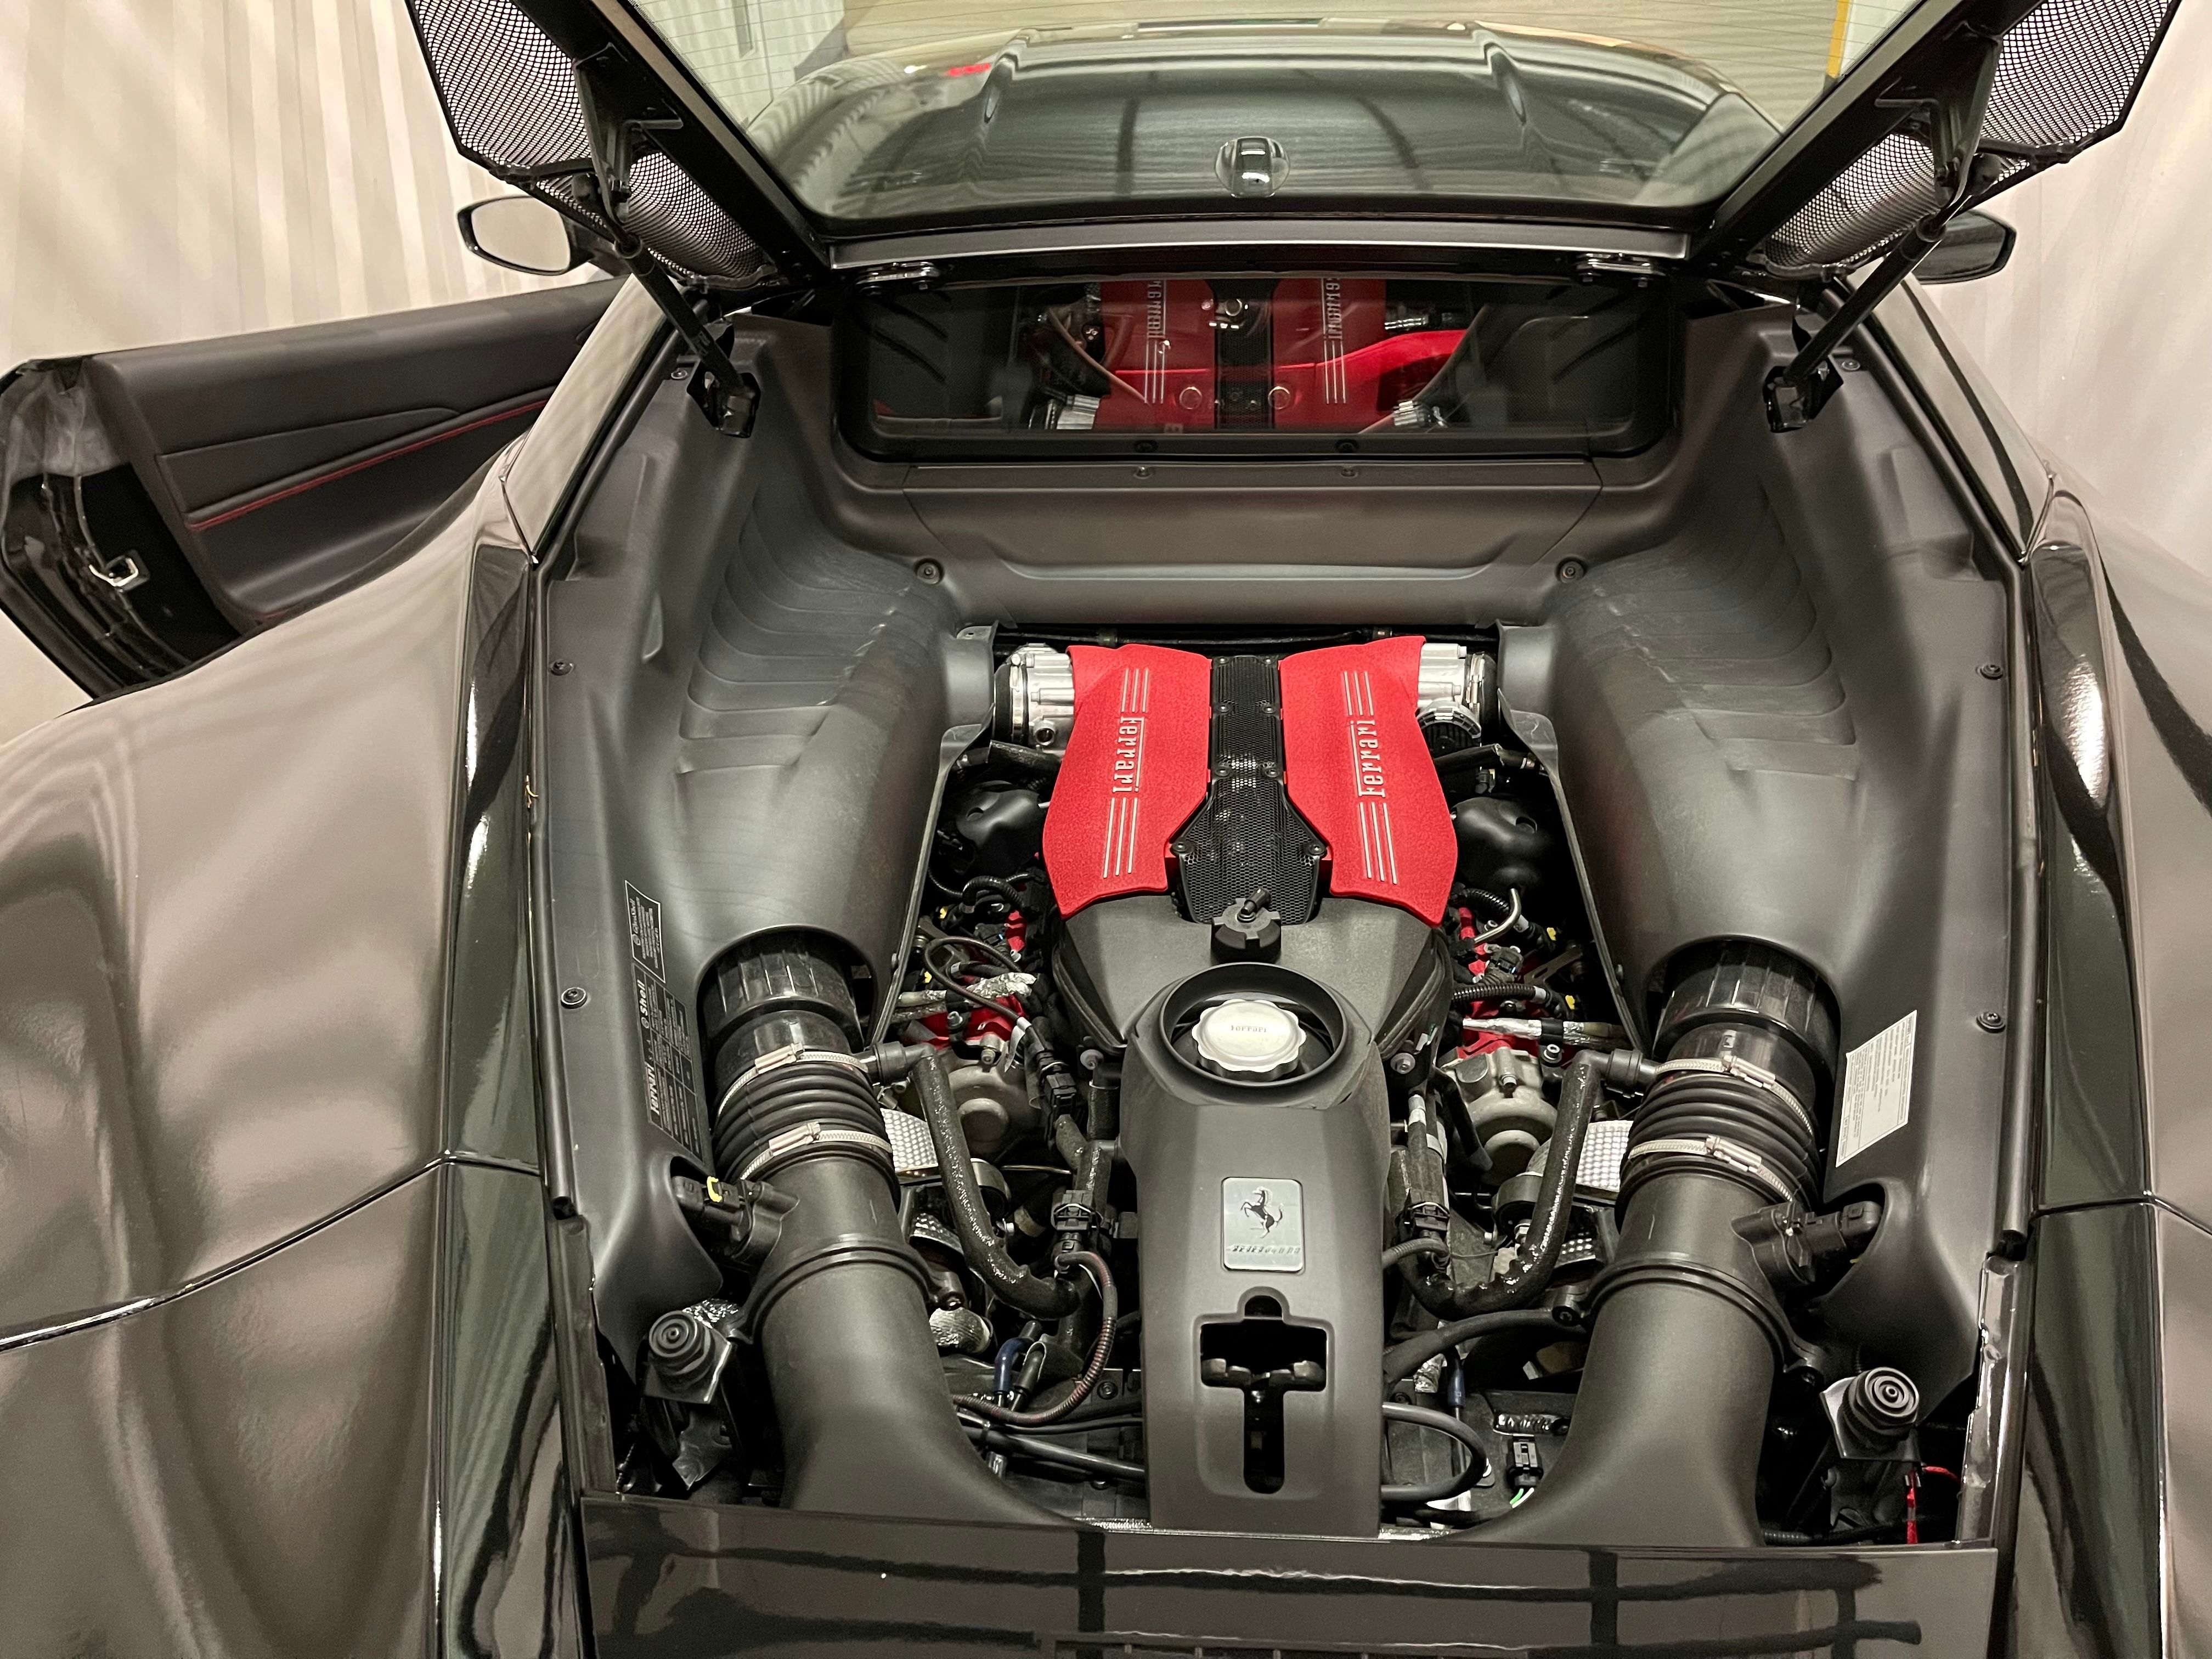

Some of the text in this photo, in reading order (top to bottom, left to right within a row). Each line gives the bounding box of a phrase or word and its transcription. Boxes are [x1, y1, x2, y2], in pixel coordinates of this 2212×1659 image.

[1113, 716, 1145, 793] Ferrari
[1350, 720, 1386, 798] Ferrari
[637, 979, 648, 1015] Shell
[644, 1061, 660, 1116] Ferrari
